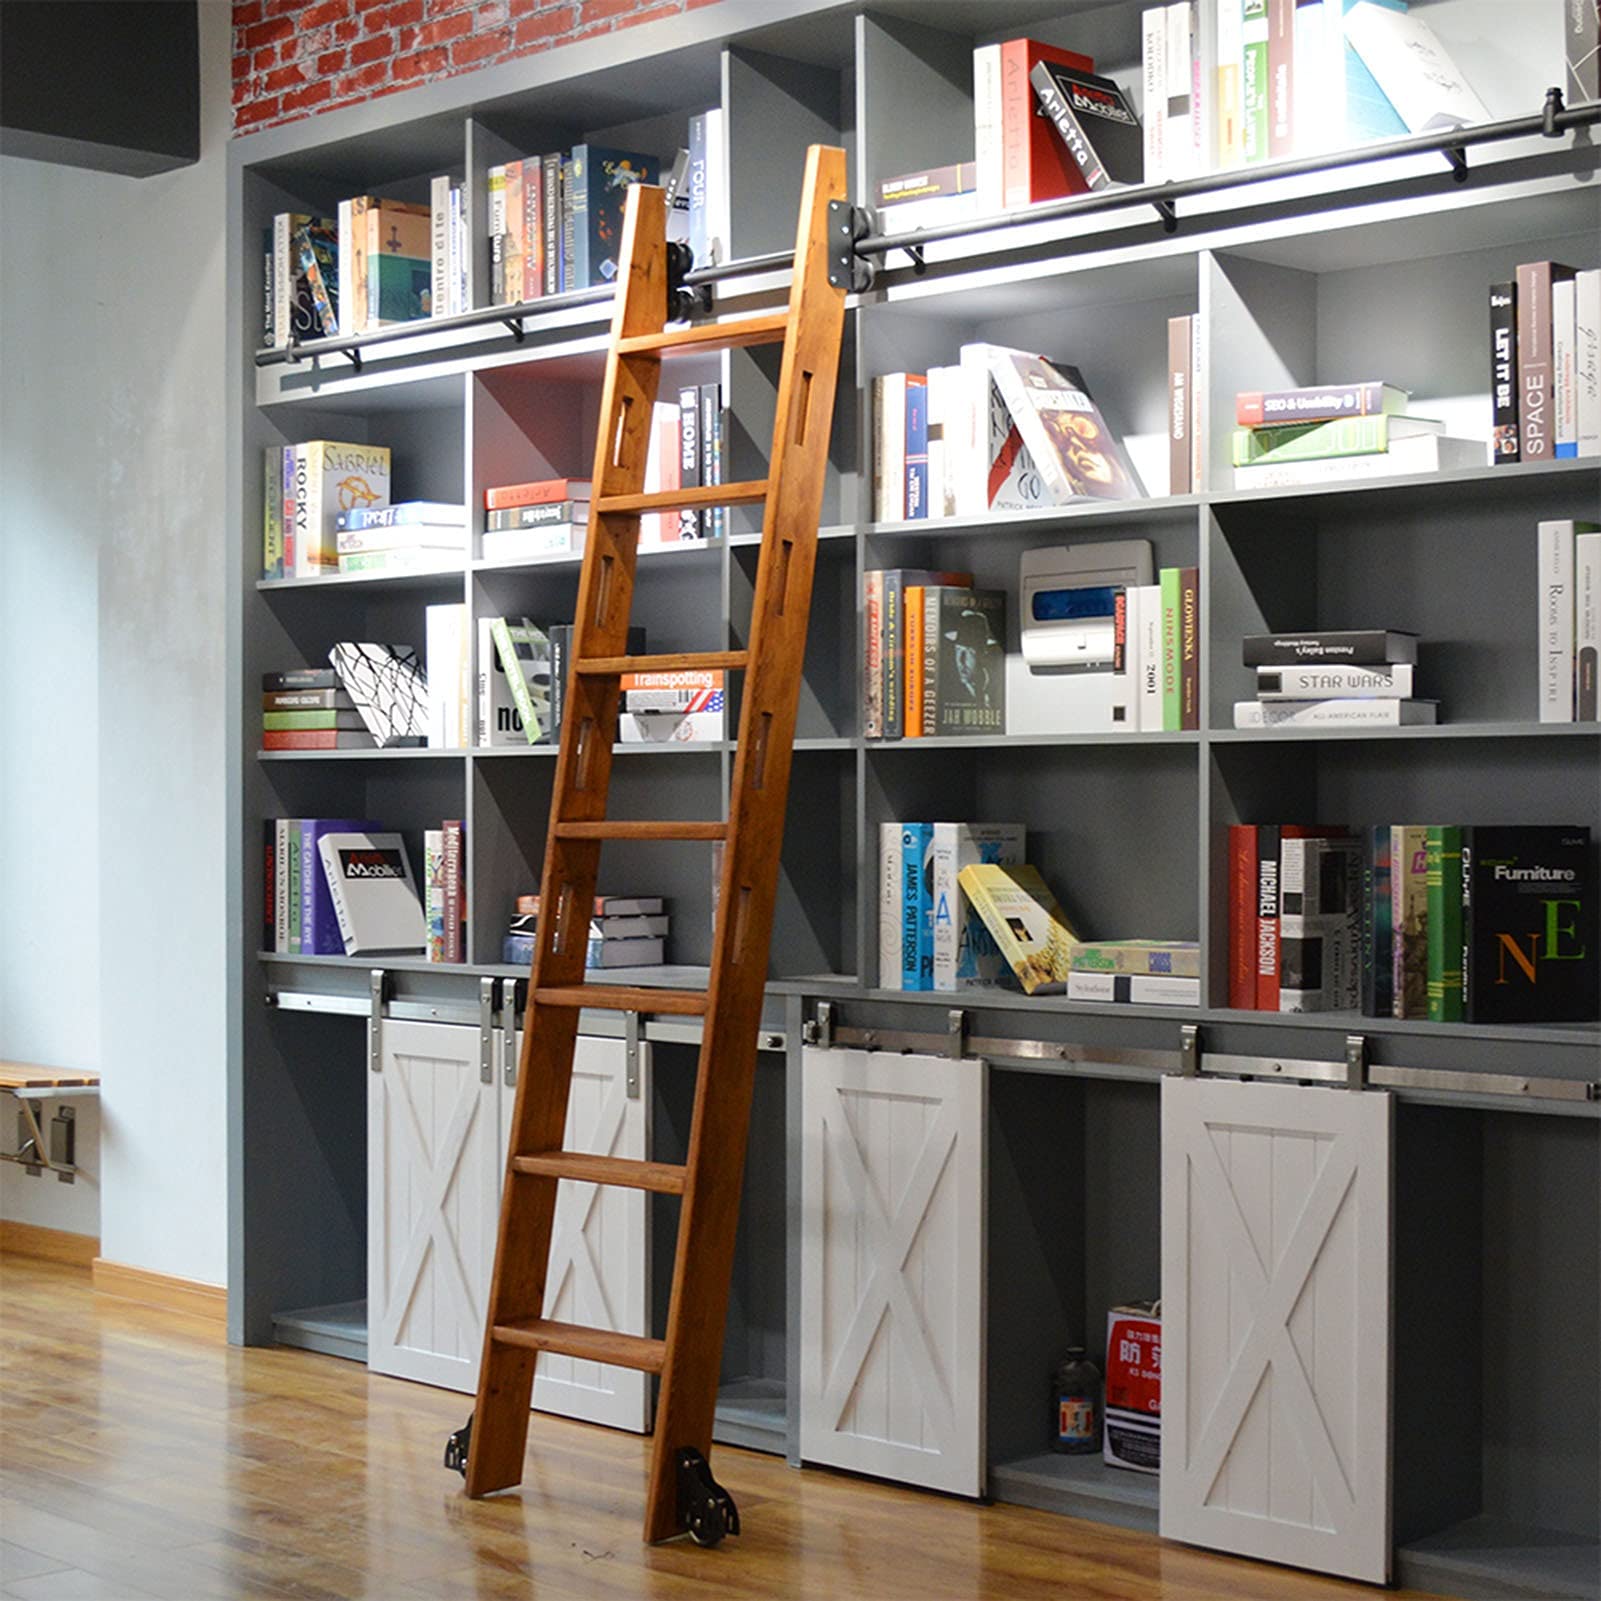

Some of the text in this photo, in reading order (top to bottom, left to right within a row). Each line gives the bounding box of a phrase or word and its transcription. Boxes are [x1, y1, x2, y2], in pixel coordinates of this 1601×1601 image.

[1039, 88, 1089, 166] Arletta
[435, 212, 444, 229] te
[435, 258, 444, 315] Dentro
[1495, 328, 1509, 408] LET IT BE
[1264, 391, 1342, 411] SEO & Usability
[1526, 373, 1545, 455] SPACE
[682, 412, 696, 470] HOME
[296, 457, 307, 530] ROCKY
[635, 671, 714, 688] Trainspotting
[923, 596, 937, 735] MEMOIRS OF A GEEZER
[1147, 664, 1156, 694] 2001
[1299, 674, 1394, 689] STAR WARS
[1494, 865, 1576, 881] Furniture
[905, 864, 917, 972] JAMES PATTERSON
[1258, 860, 1277, 976] MICHAEL JACKSON
